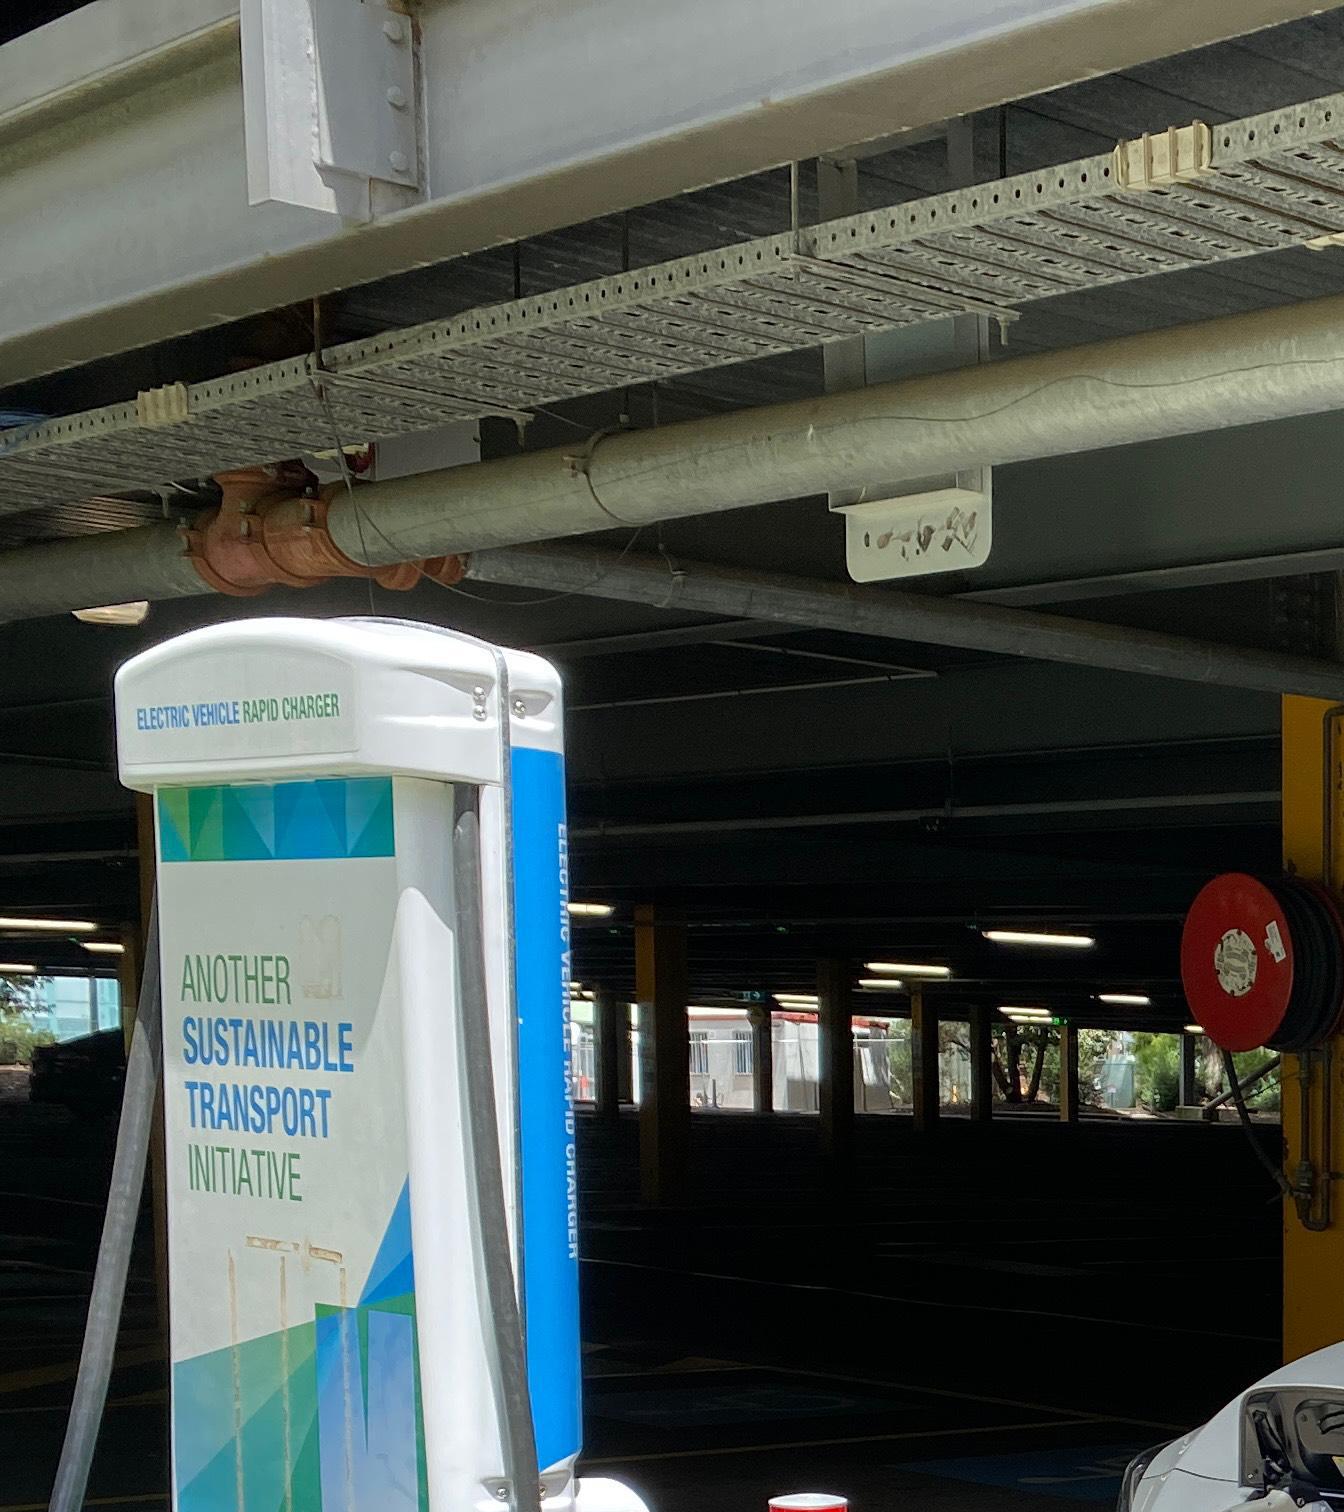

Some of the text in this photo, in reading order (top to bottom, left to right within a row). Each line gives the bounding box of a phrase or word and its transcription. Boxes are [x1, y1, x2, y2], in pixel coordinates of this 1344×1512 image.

[136, 693, 340, 730] ELECTRIC VEHICLE RAPID CHARGER
[181, 954, 291, 1006] ANOTHER
[182, 1016, 354, 1073] SUSTAINABLE
[184, 1080, 332, 1139] TRANSPORT
[187, 1143, 303, 1202] INITIATIVE
